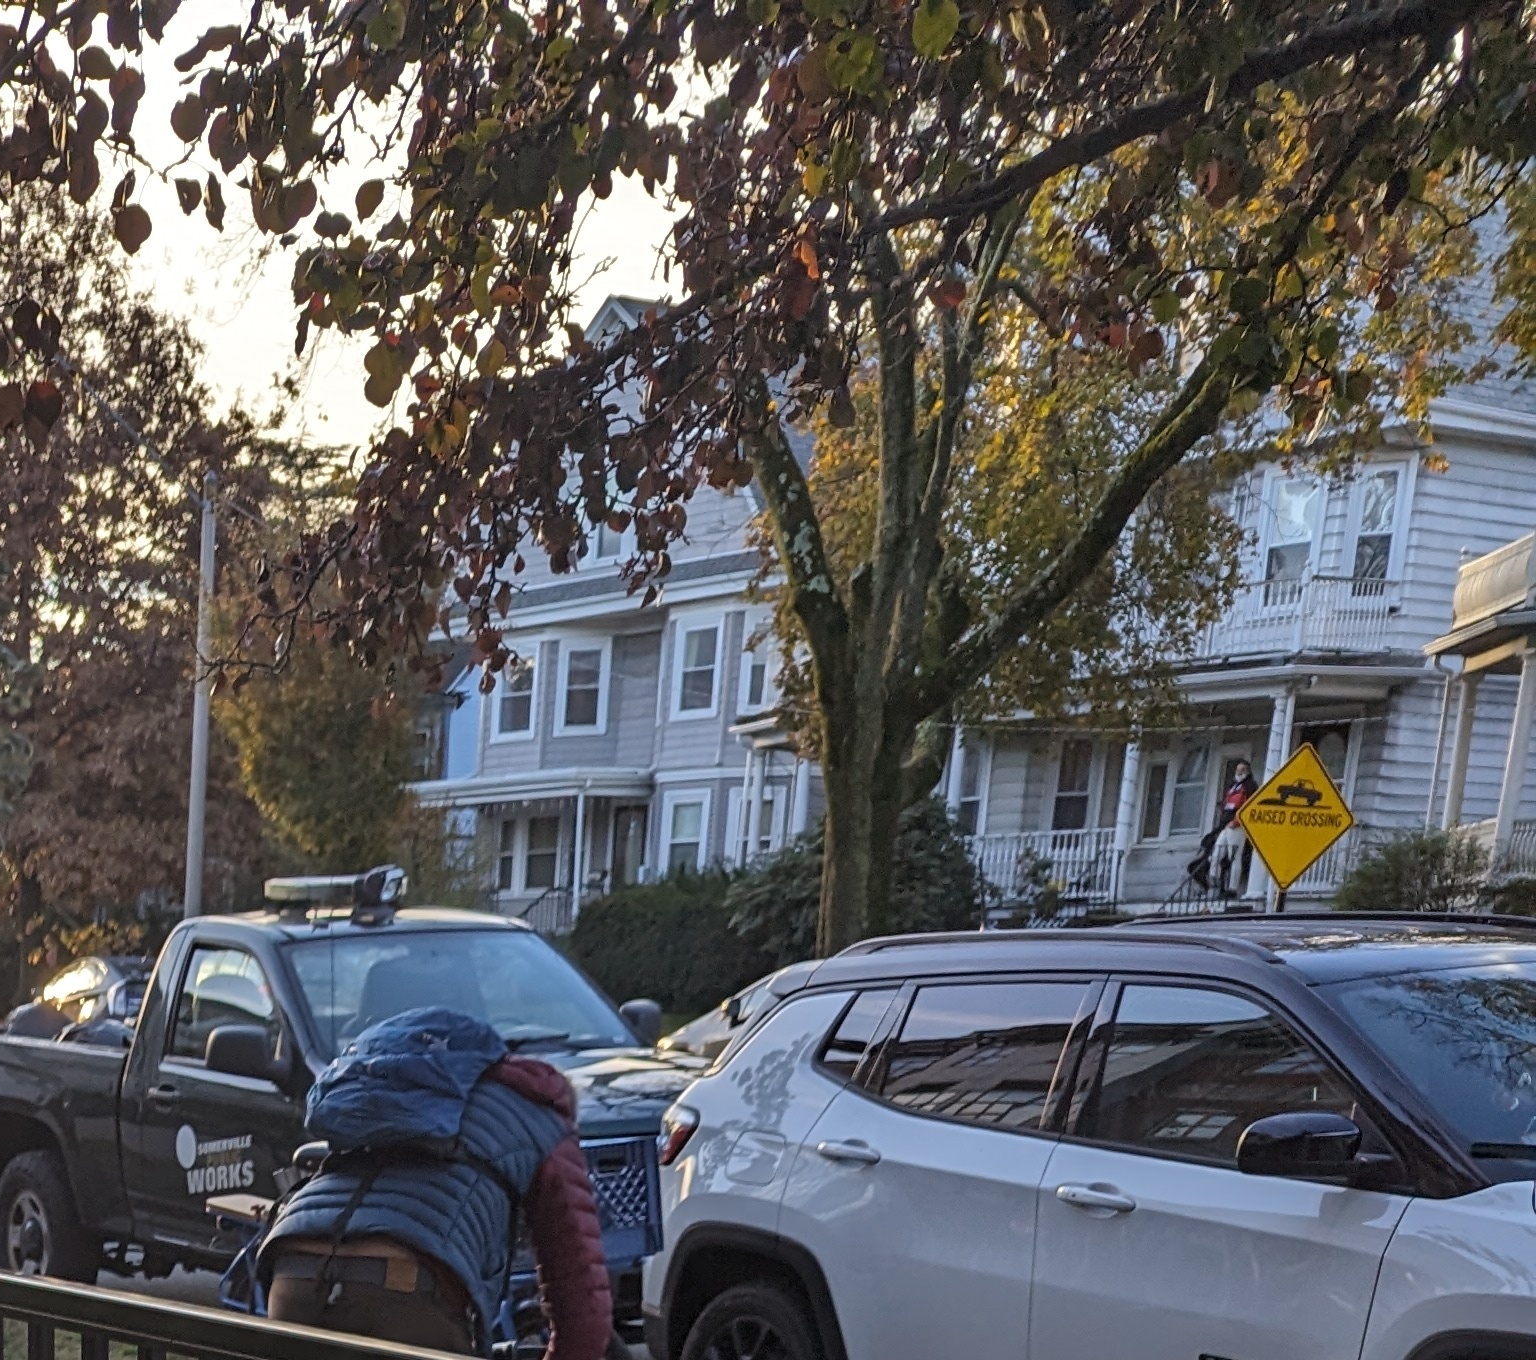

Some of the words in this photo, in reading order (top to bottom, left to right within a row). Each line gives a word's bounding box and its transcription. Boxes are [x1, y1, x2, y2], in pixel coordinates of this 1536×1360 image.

[1249, 809, 1286, 825] RAISED
[1290, 811, 1343, 828] CROSSING
[197, 1134, 253, 1156] SOMERVILLE
[186, 1160, 254, 1195] WORKS
